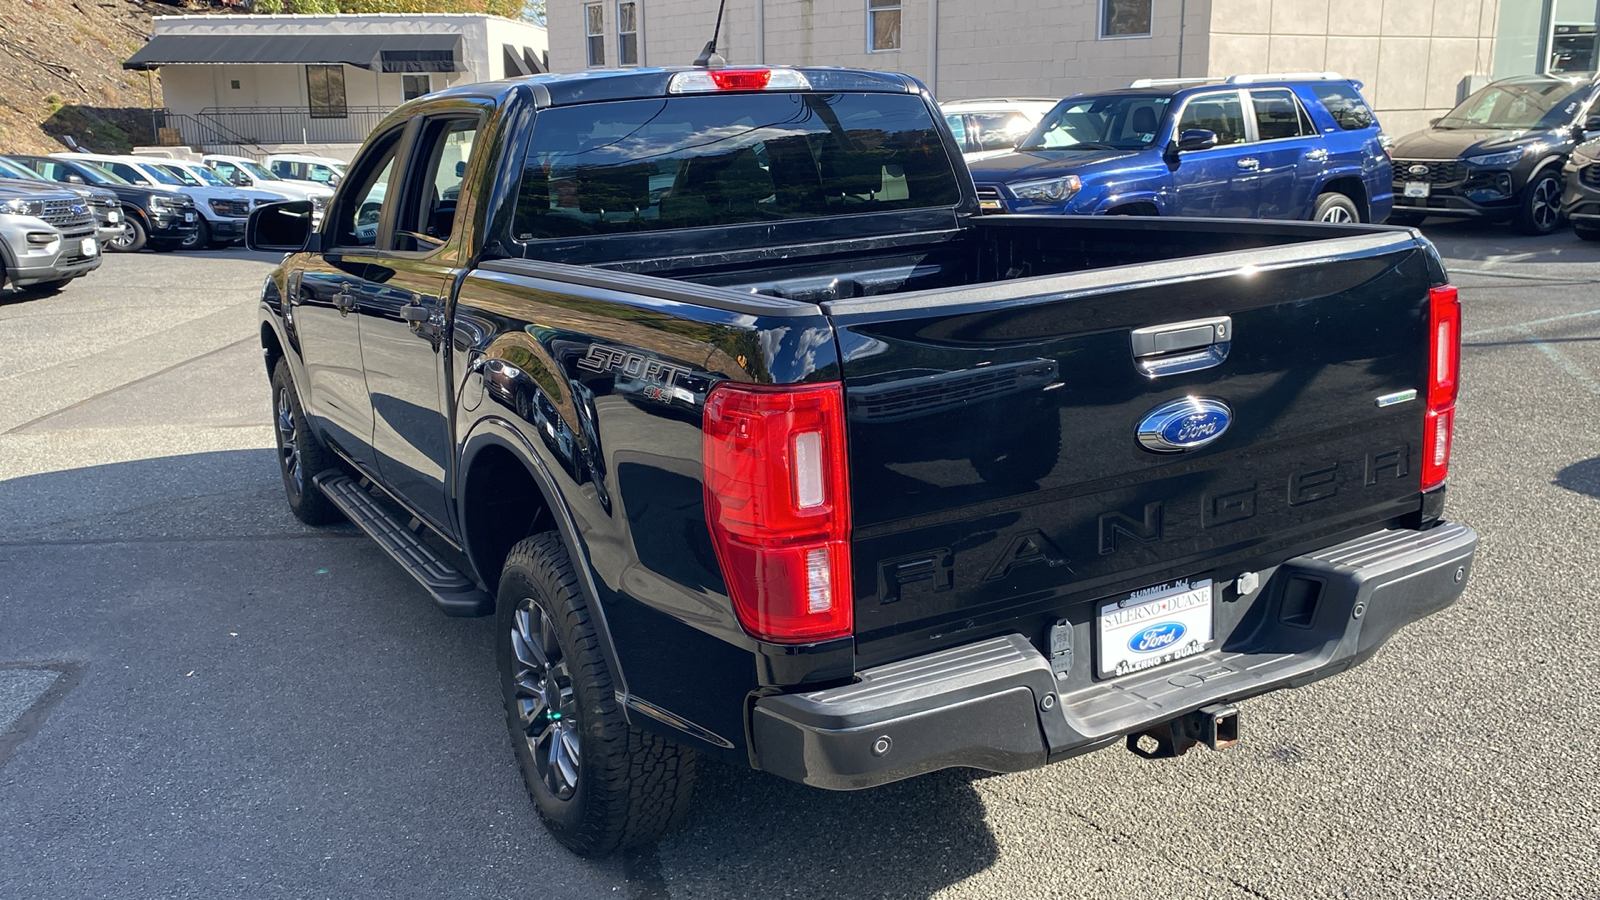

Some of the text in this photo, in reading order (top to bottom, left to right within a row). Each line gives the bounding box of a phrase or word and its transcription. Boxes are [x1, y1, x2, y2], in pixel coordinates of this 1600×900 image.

[577, 342, 692, 389] SPORT
[877, 443, 1411, 605] RANGER
[1104, 590, 1209, 628] SALERNO DUANE
[1139, 626, 1176, 650] Ford
[1115, 642, 1205, 676] SALERNO DUANE
